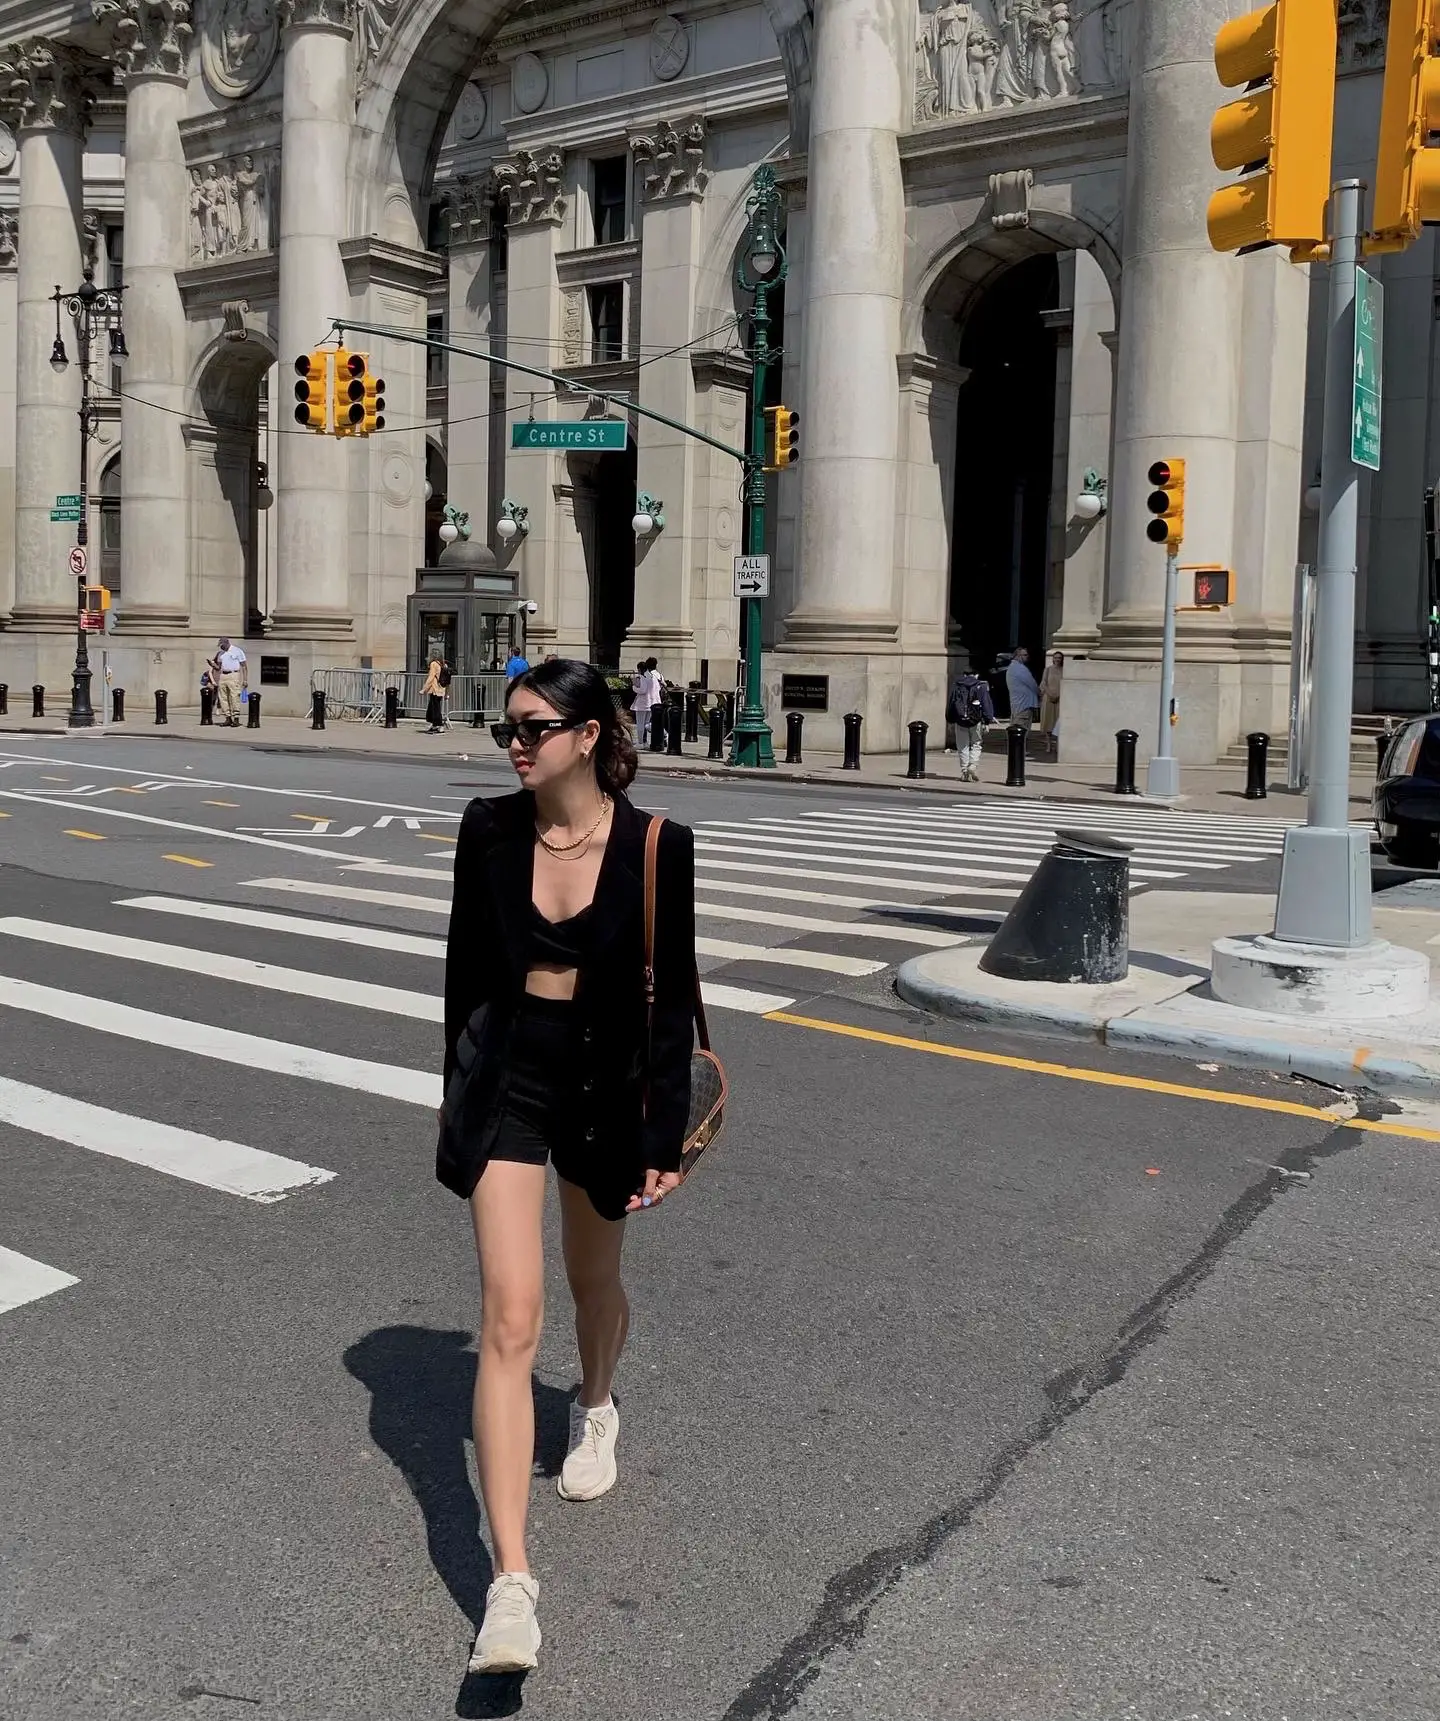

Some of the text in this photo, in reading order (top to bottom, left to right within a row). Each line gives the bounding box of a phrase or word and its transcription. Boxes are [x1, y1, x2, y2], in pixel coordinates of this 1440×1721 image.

[529, 428, 605, 443] Centre St
[742, 559, 760, 569] ALL
[737, 570, 766, 579] TRAFFIC
